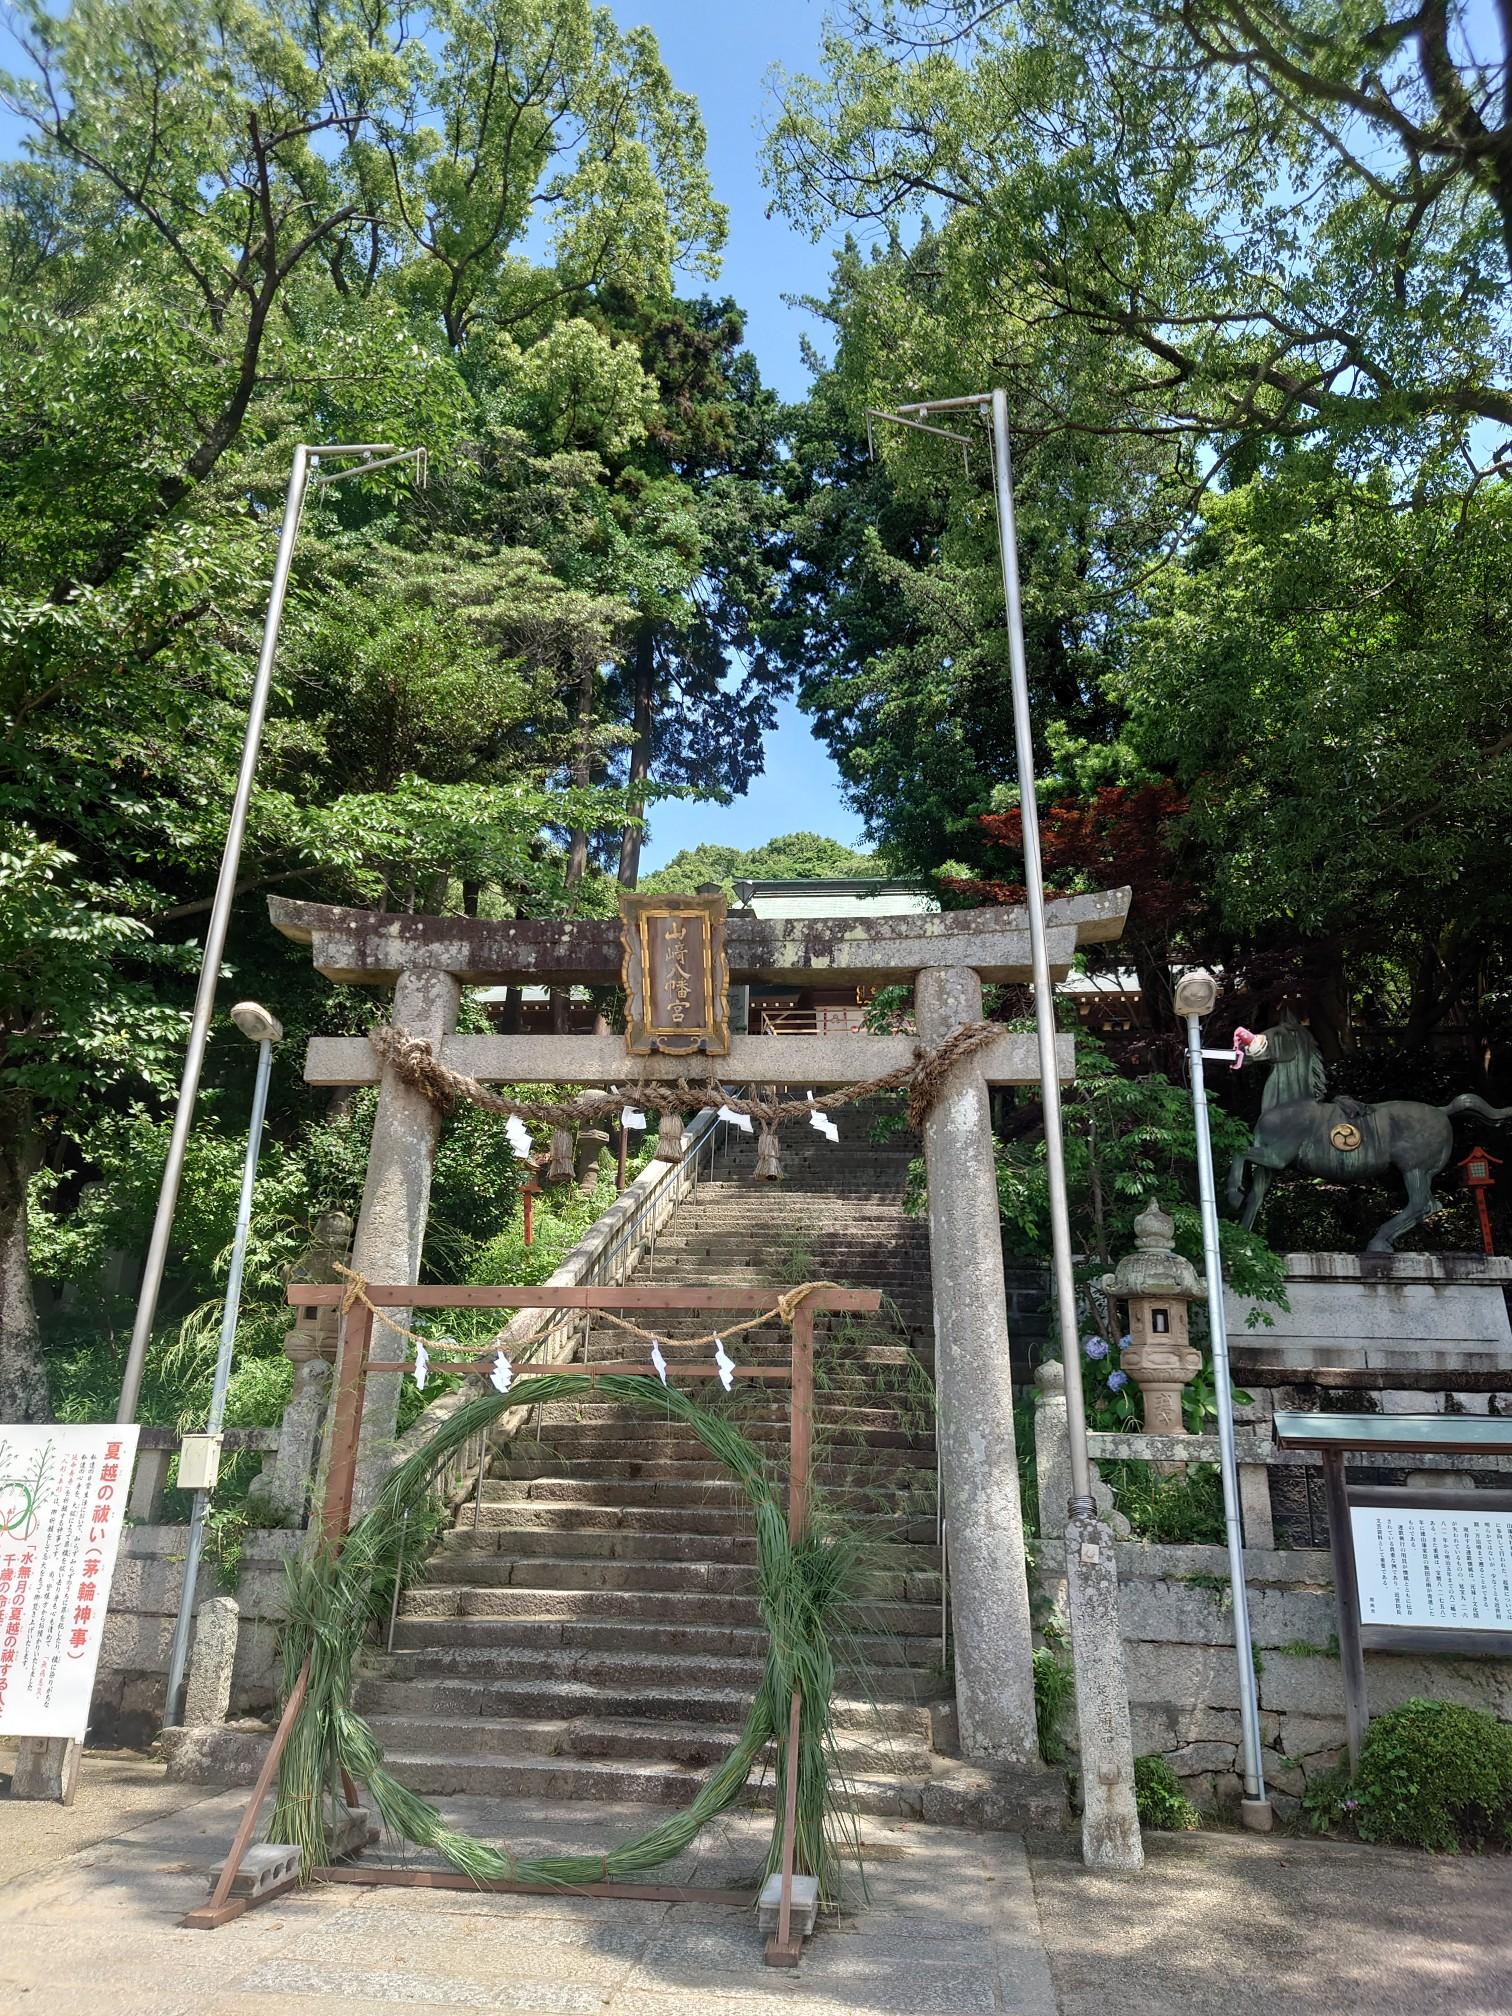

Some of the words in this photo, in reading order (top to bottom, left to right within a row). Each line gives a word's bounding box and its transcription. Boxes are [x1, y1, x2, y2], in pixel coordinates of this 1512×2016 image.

[0, 1545, 36, 1718] 「水無月の夏越の祓する
[67, 1442, 123, 1659] 夏越の祓い（茅輪神事）
